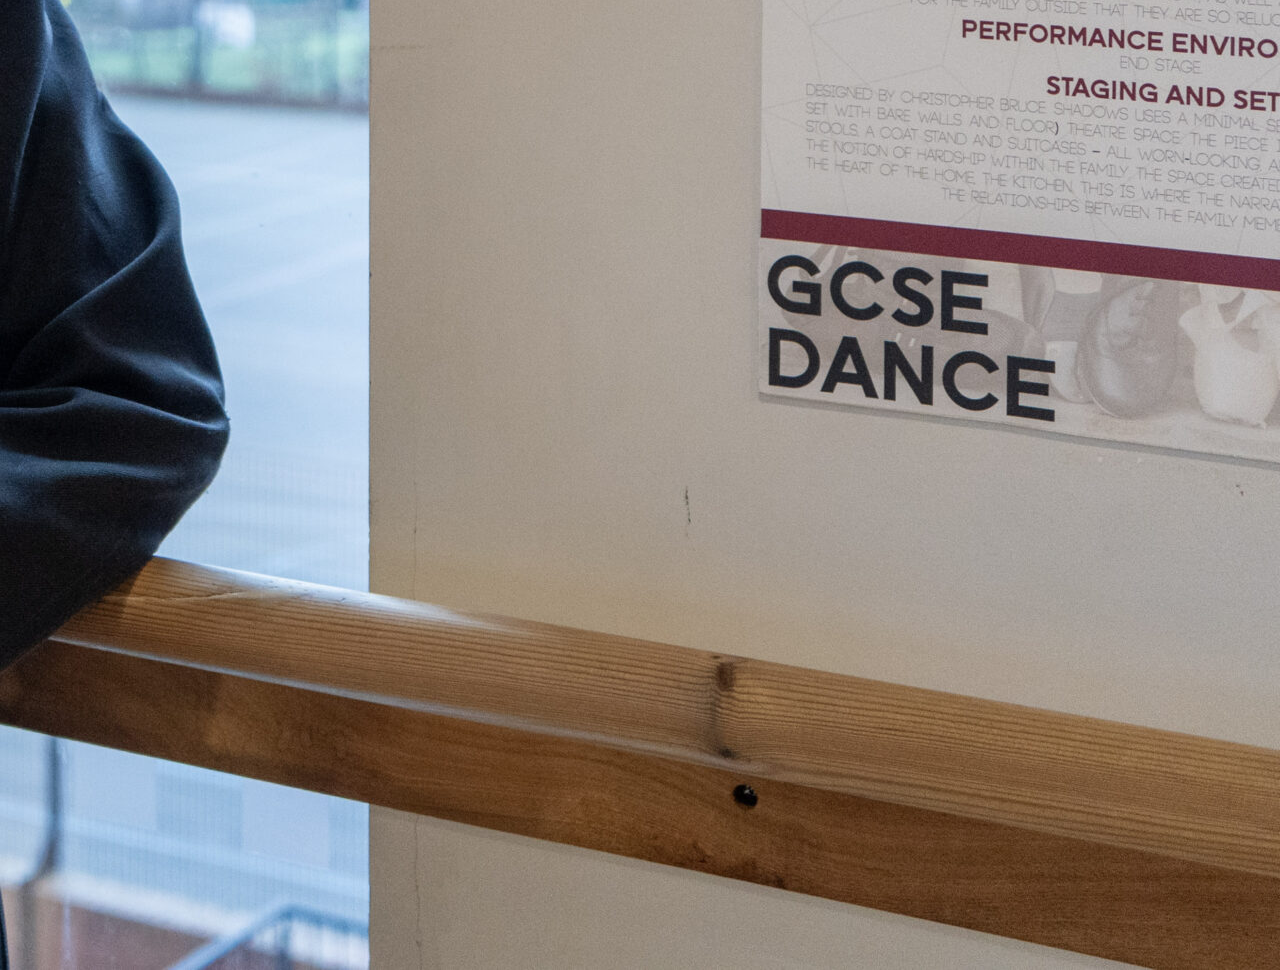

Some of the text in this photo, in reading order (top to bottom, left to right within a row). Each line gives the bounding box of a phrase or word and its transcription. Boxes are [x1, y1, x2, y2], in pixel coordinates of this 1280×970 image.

[1092, 1, 1129, 17] THAT
[1133, 3, 1170, 20] THEY
[1173, 6, 1203, 22] ARE
[1207, 8, 1231, 24] SO
[961, 19, 1278, 58] PERFORMANCE ENVIRO
[1119, 55, 1201, 73] END STAGE
[1046, 75, 1280, 112] STAGING AND SET
[941, 186, 1238, 228] THE RELATIONSHIPS BETWEEN THE FAMILY
[767, 254, 988, 335] GCSE
[768, 327, 1056, 422] DANCE
